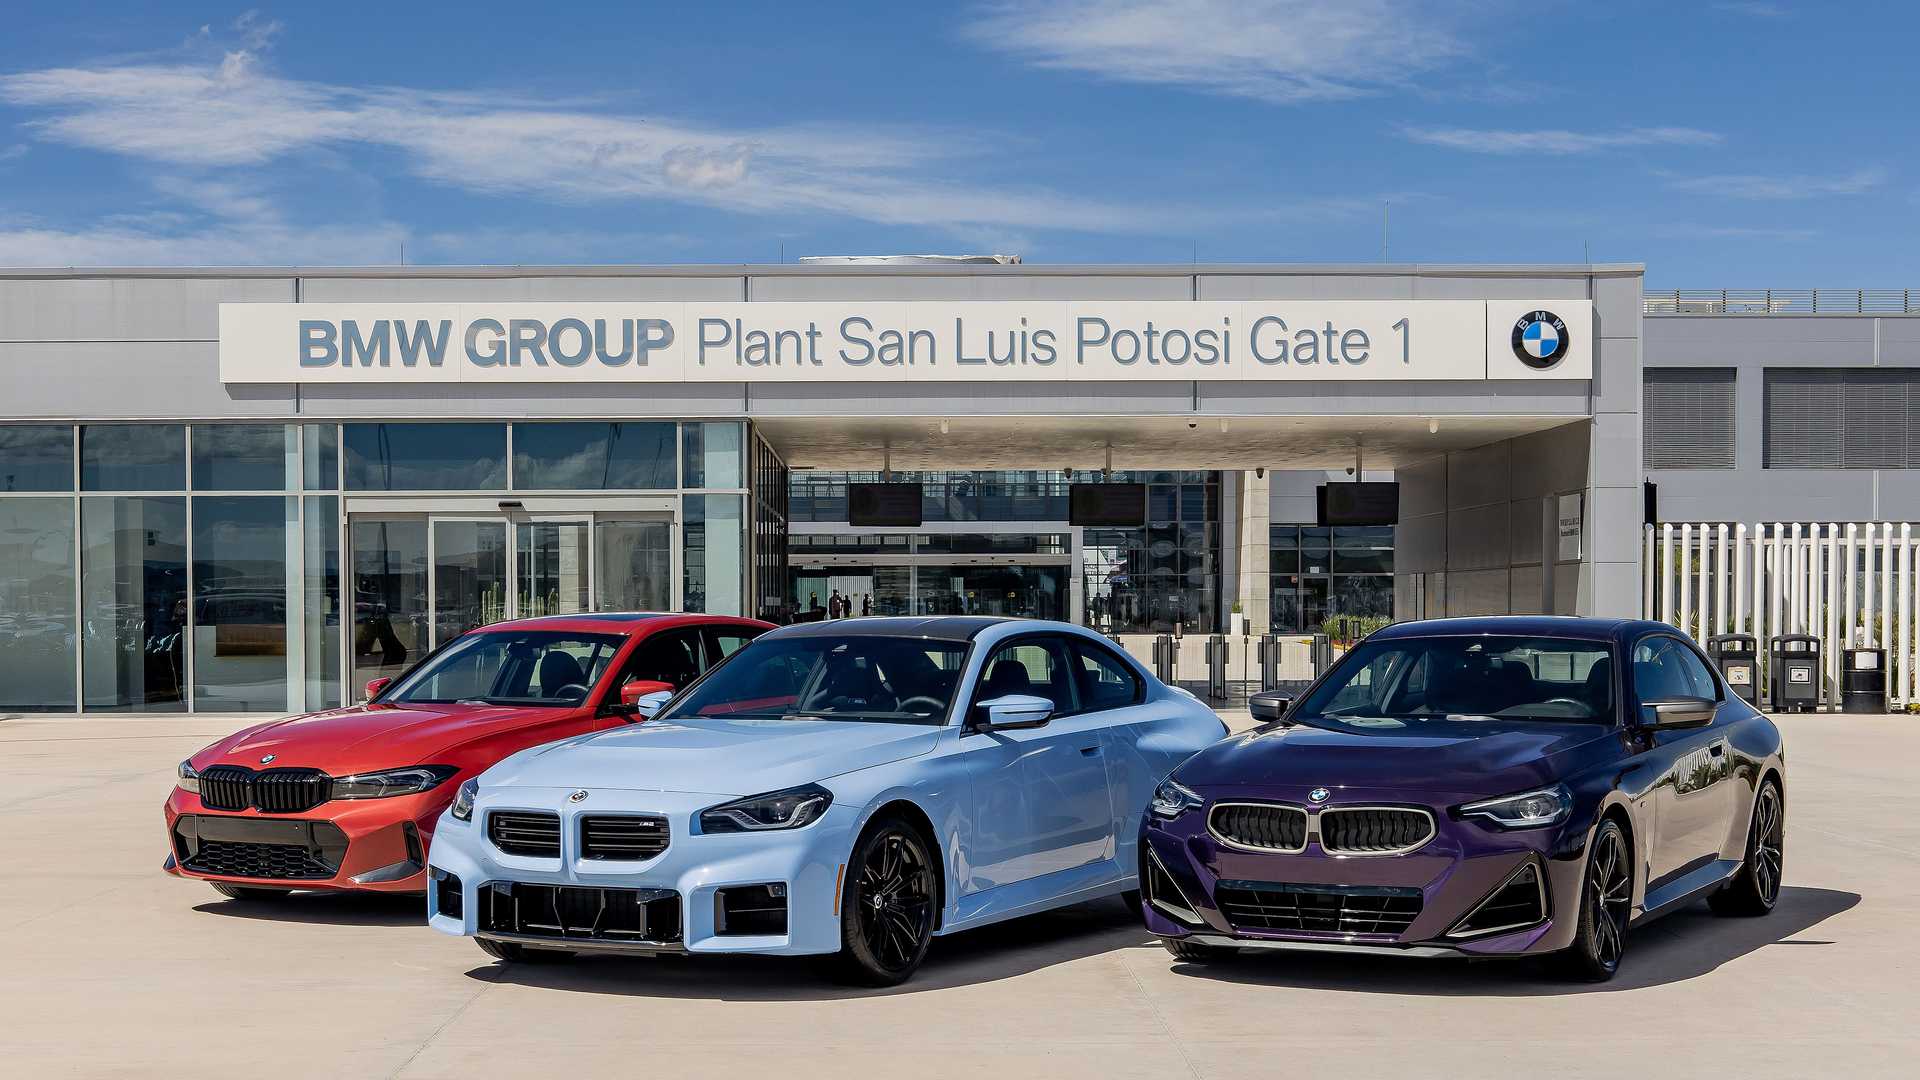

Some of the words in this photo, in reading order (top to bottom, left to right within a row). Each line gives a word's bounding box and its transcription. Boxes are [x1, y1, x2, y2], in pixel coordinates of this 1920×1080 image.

[1516, 311, 1565, 331] BMW
[299, 319, 453, 368] BMW
[464, 318, 676, 368] GROUP
[698, 317, 825, 367] Plant
[839, 316, 936, 367] San
[956, 317, 1058, 367] Luis
[1077, 316, 1231, 366] Potosi
[1250, 315, 1371, 366] Gate
[1391, 317, 1410, 365] 1
